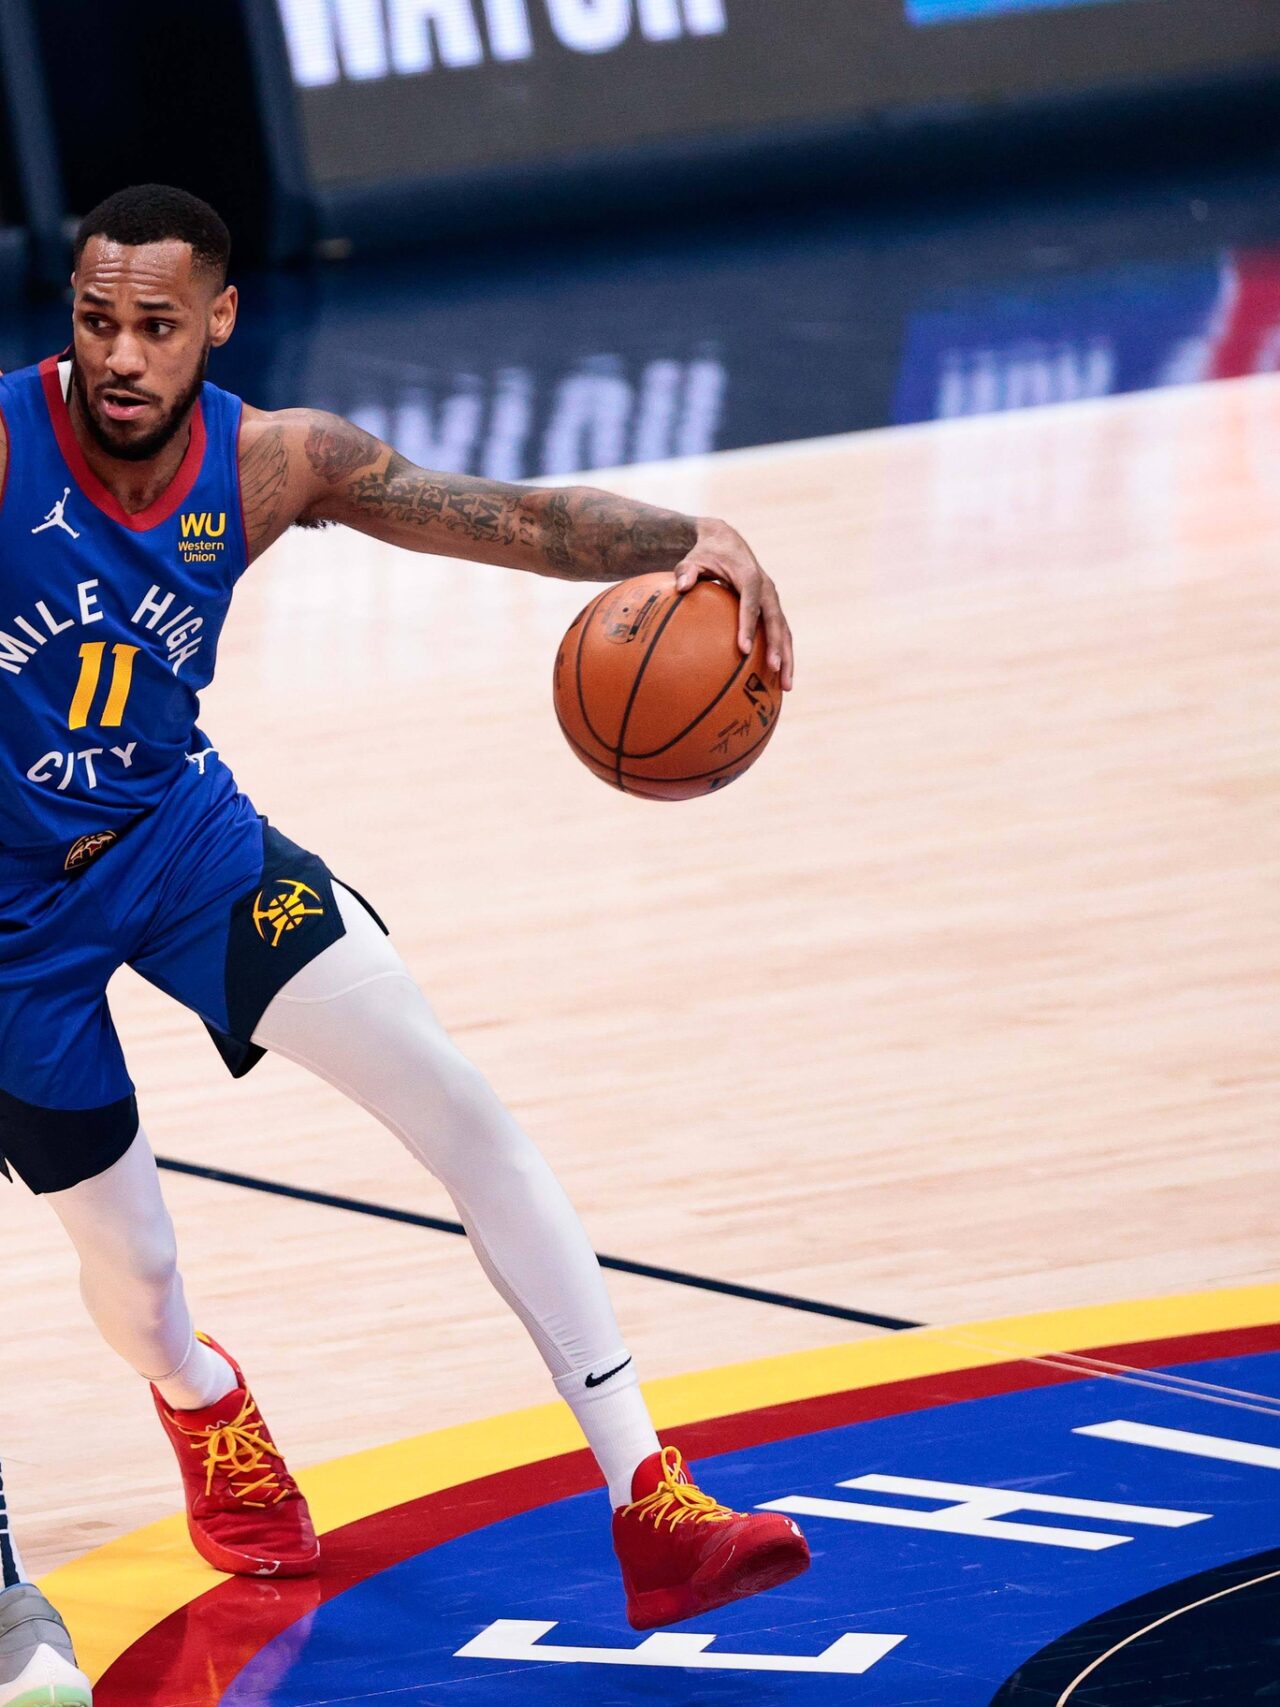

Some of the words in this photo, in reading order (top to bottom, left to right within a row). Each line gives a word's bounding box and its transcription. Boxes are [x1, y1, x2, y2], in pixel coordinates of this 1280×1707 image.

[180, 512, 226, 538] WU
[178, 540, 224, 552] Western
[183, 550, 216, 563] Union
[68, 641, 141, 731] 11
[26, 741, 137, 791] CITY
